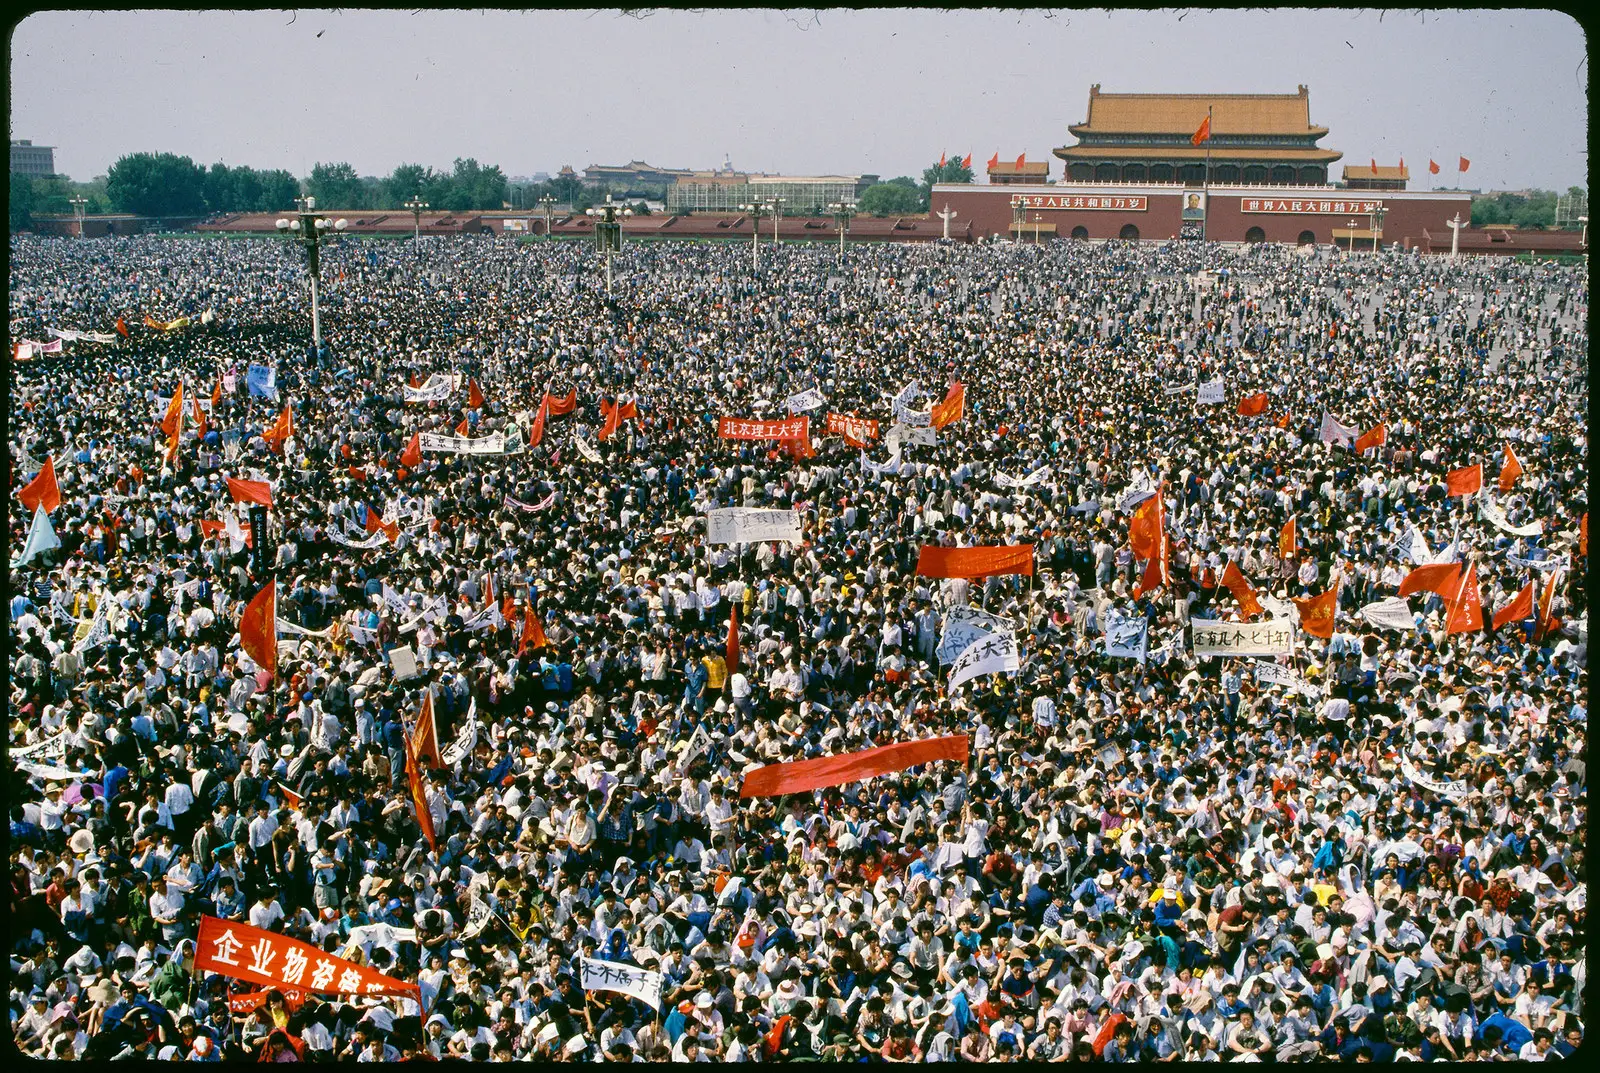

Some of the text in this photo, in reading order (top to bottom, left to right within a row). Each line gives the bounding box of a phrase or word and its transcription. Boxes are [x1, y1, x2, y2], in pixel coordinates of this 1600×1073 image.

[1018, 196, 1140, 209] 中华人民共和国万岁
[1249, 200, 1374, 214] 世界人民大团结万岁
[724, 420, 803, 439] 北京理工大学
